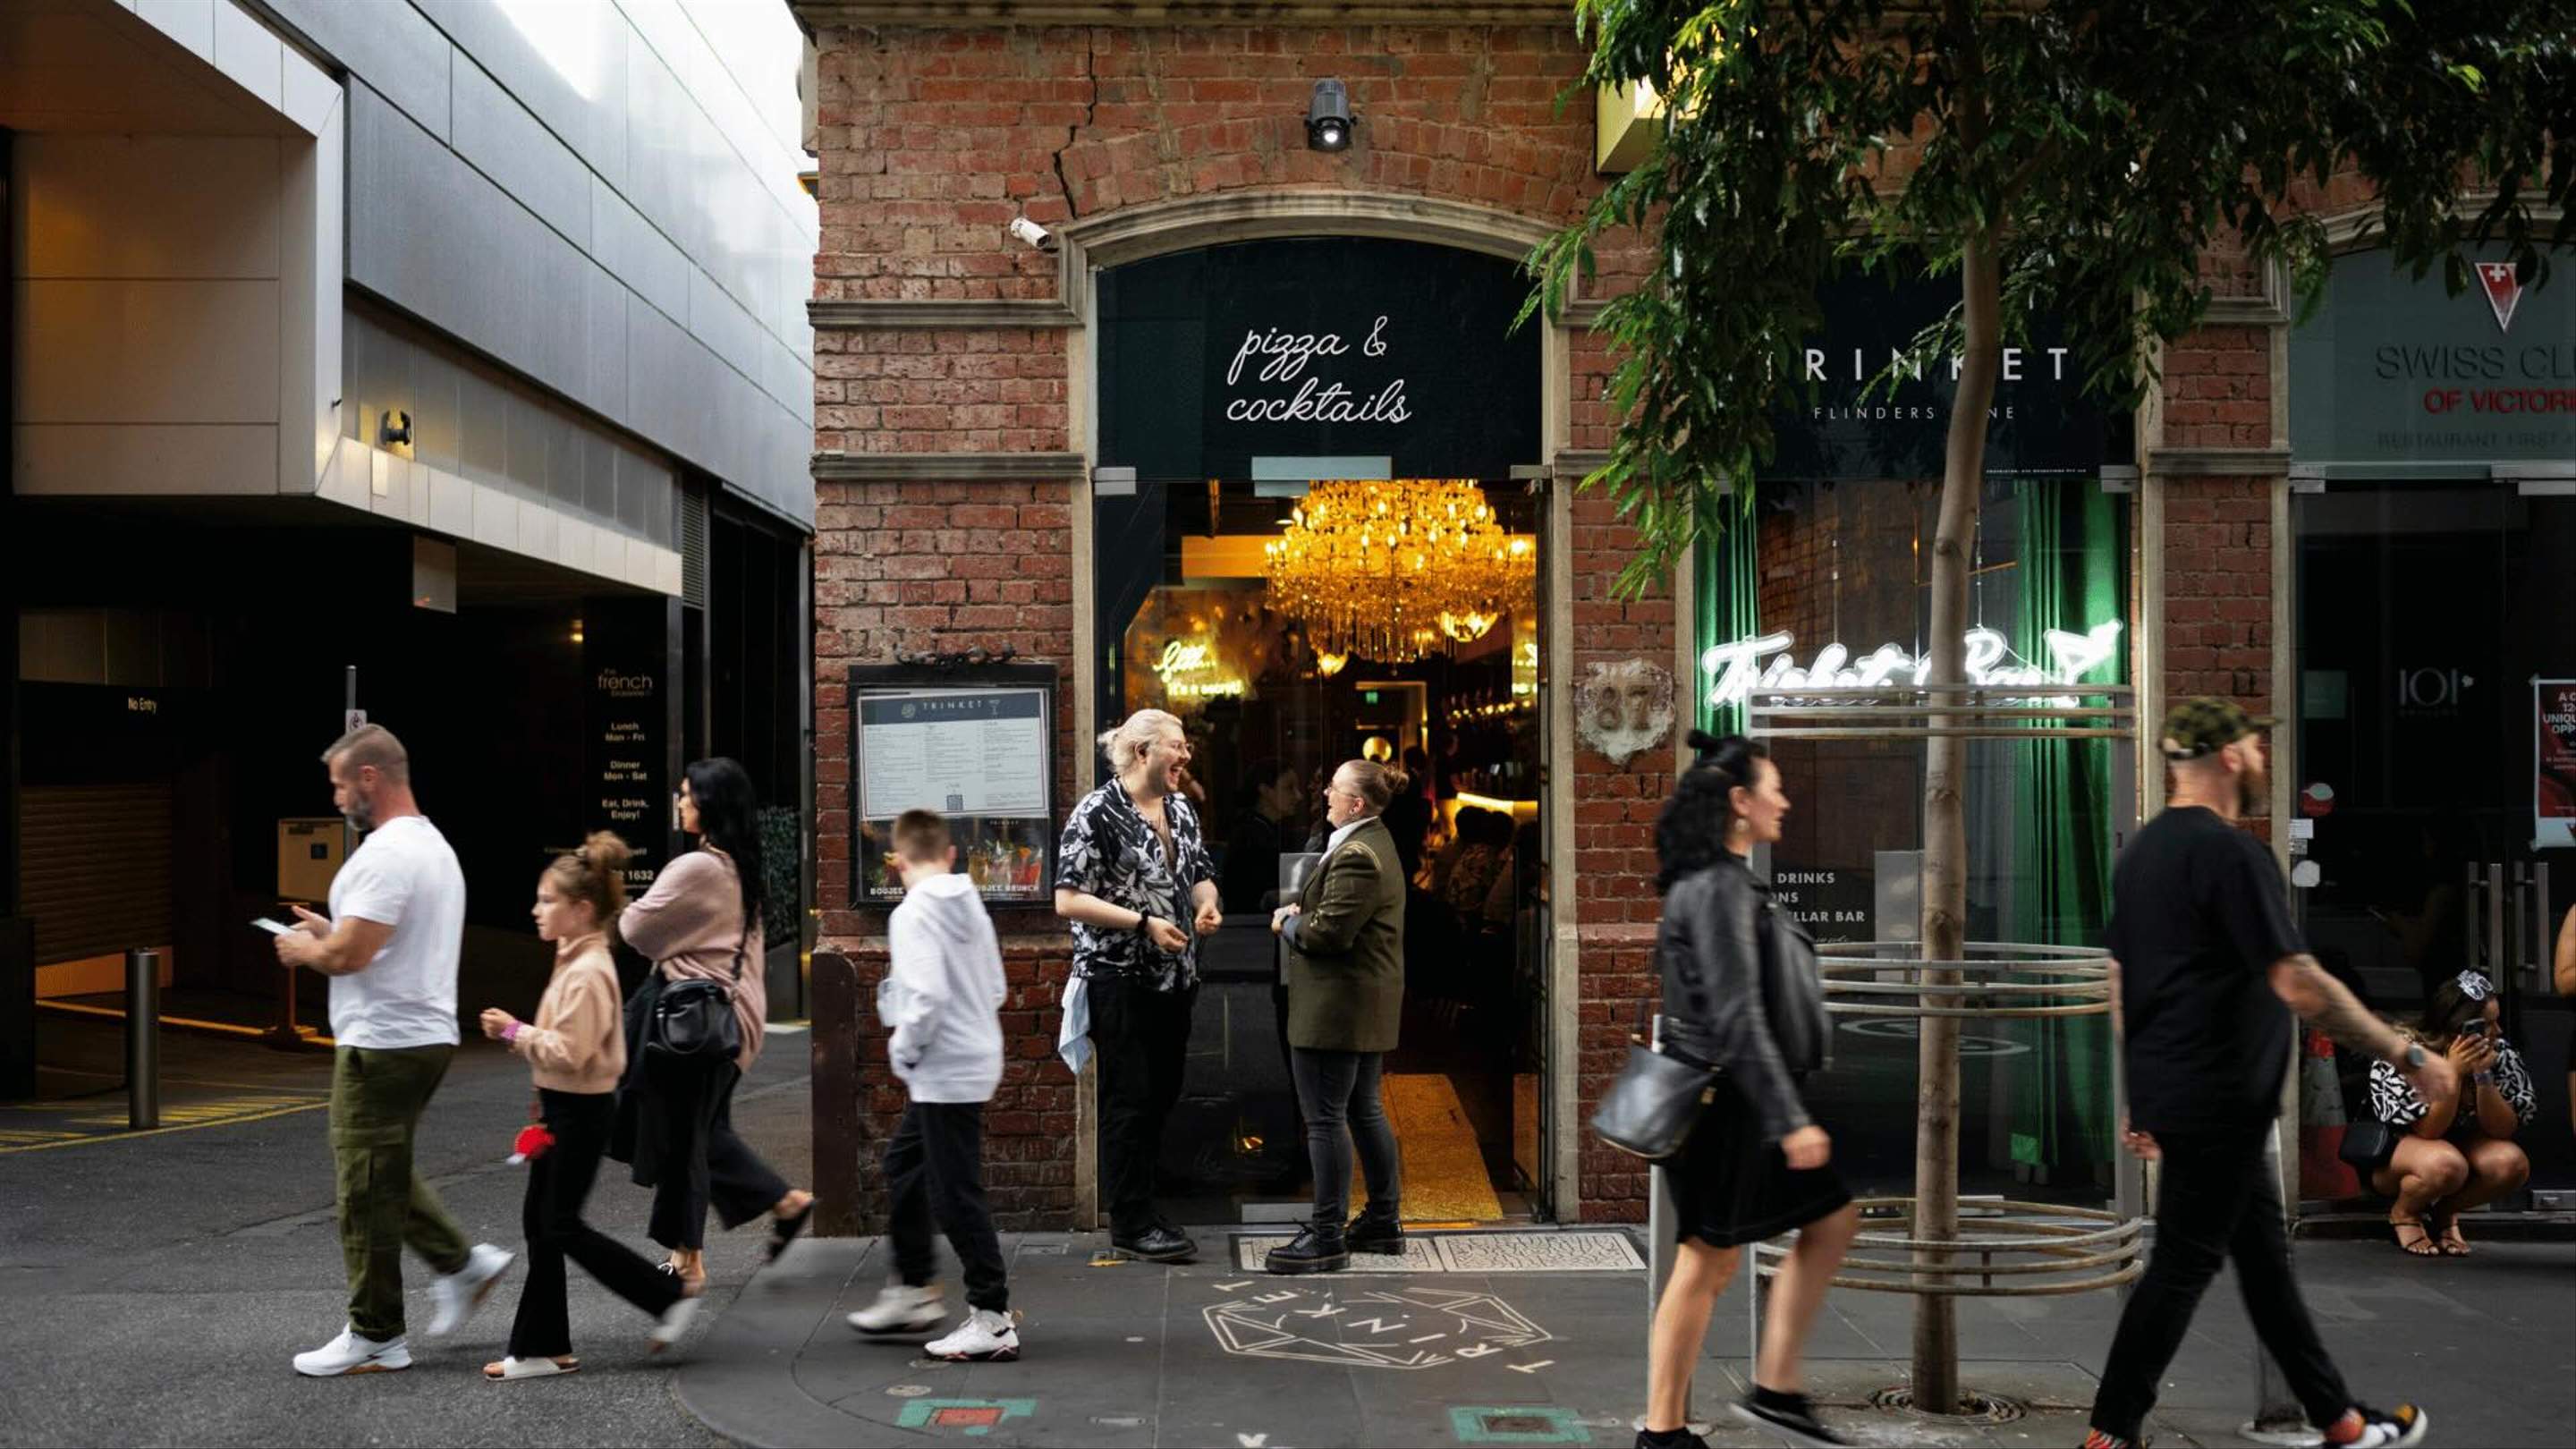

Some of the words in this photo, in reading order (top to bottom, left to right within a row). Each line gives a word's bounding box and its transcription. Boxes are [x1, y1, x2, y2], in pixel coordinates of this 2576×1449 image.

[1227, 326, 1351, 386] pizza
[1363, 316, 1387, 356] &
[2376, 344, 2504, 380] SWISS
[2520, 344, 2576, 380] CL
[1227, 377, 1411, 423] cocktails
[2423, 386, 2463, 414] OF
[1814, 407, 1935, 420] FLINDERS
[597, 673, 653, 690] french
[128, 697, 139, 711] No
[140, 697, 157, 716] Entry
[923, 699, 982, 710] TRINKET
[611, 722, 640, 731] Lunch
[606, 733, 625, 741] Mon
[632, 733, 646, 741] Fri
[610, 760, 640, 769] Dinner
[604, 771, 624, 780] Mon
[631, 771, 648, 780] Sat
[601, 799, 621, 809] Eat,
[611, 809, 640, 821] Enjoy!
[1777, 872, 1835, 884] DRINKS
[1788, 911, 1829, 922] LLAR
[1835, 911, 1866, 922] BAR
